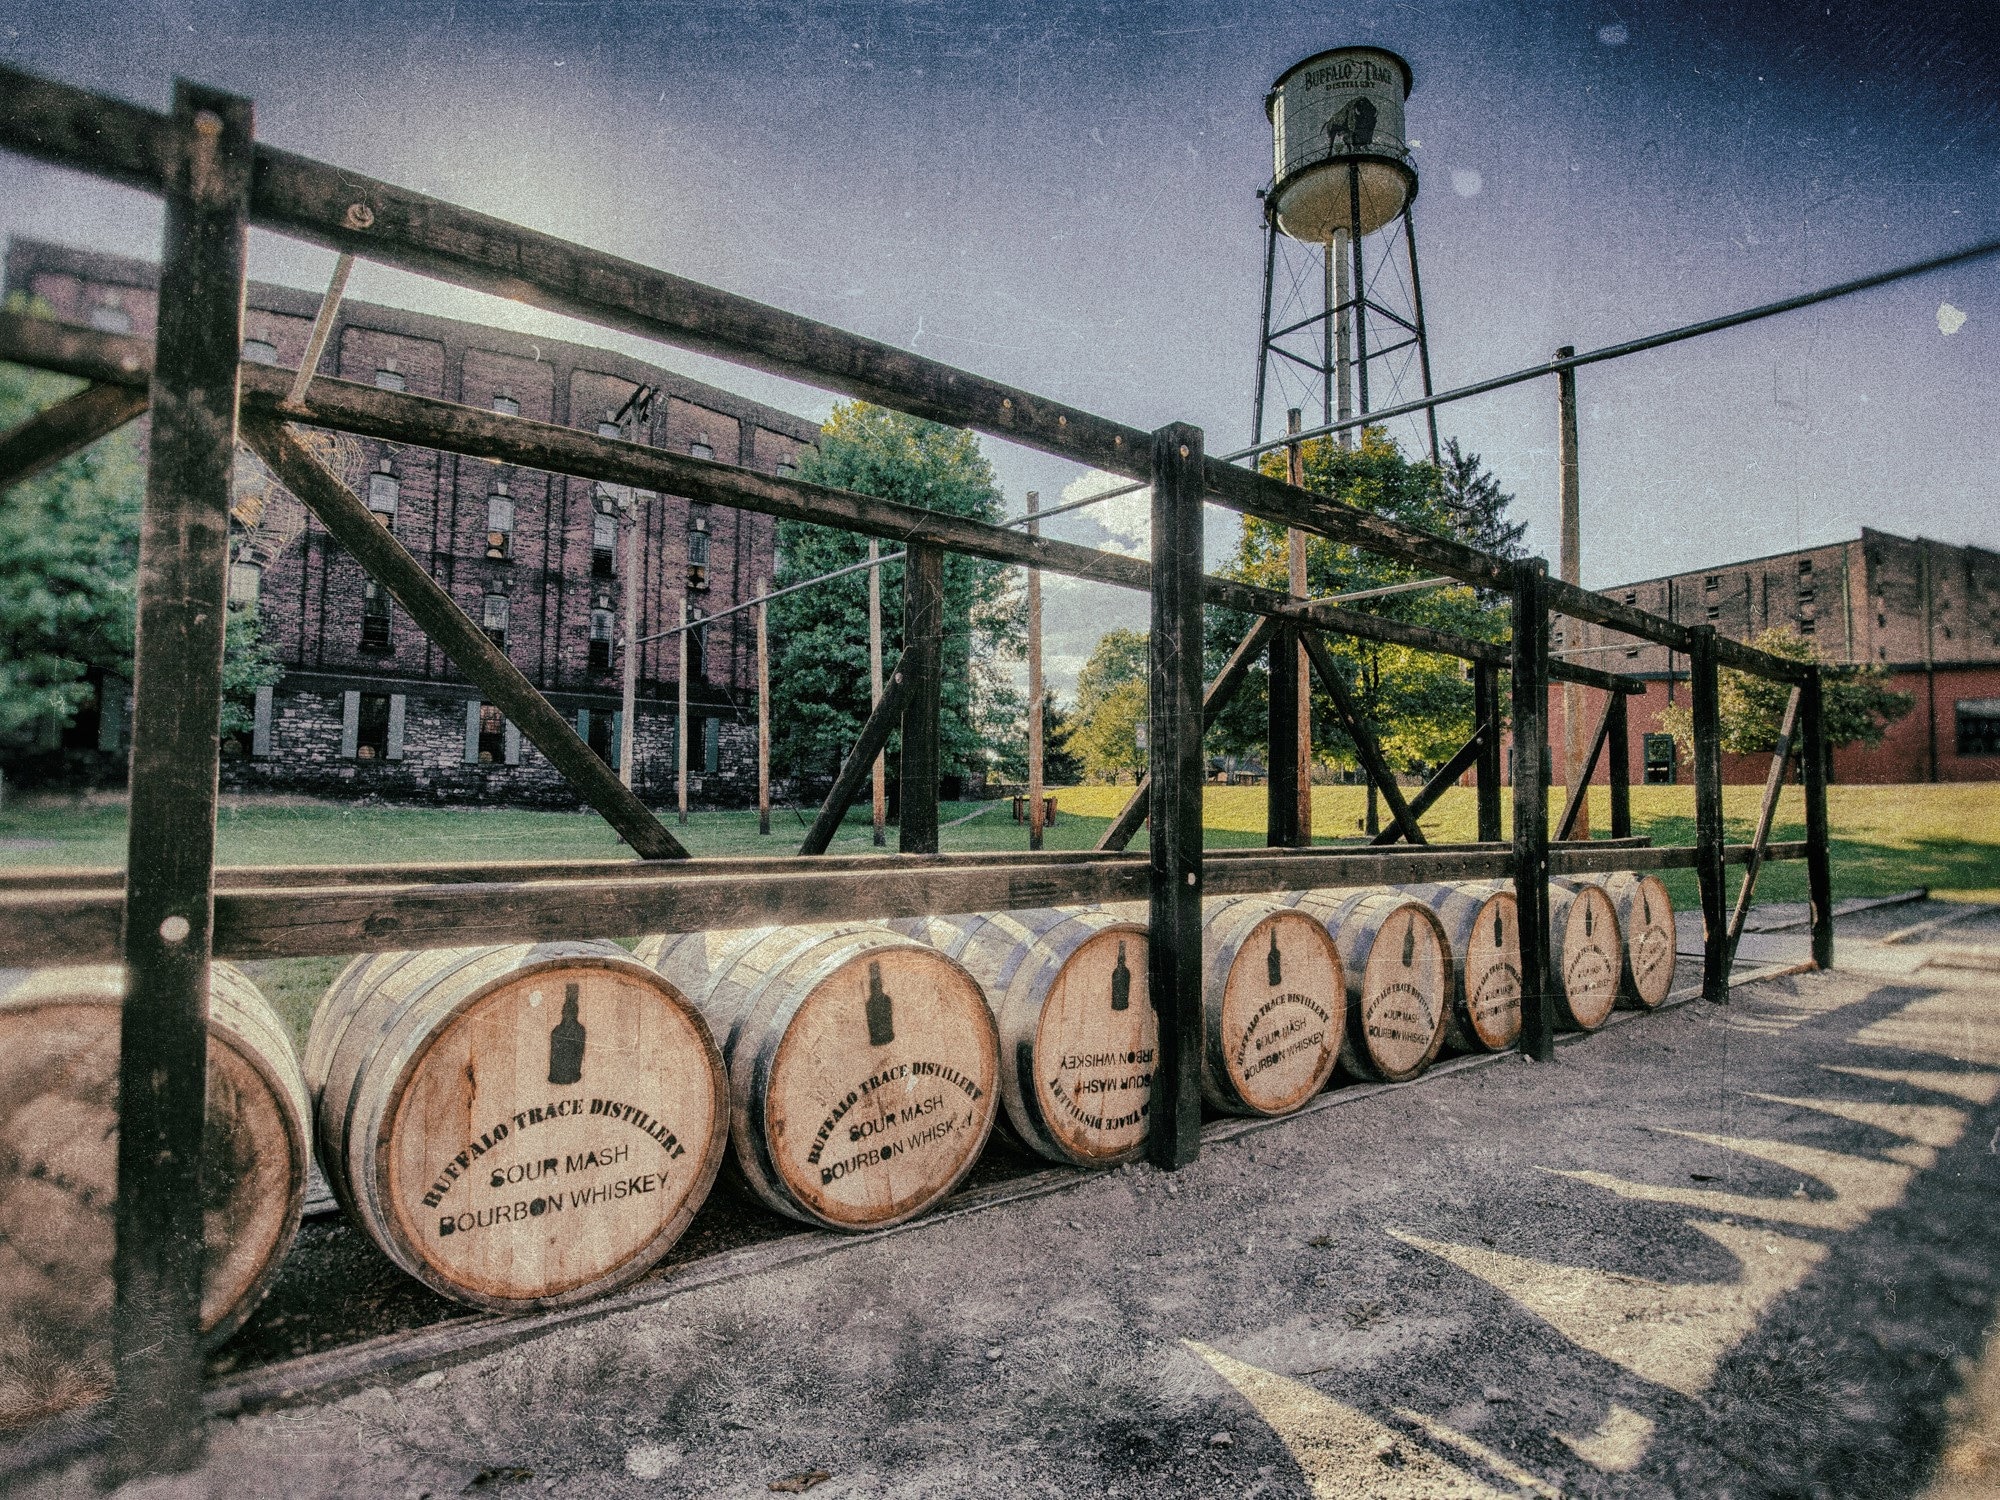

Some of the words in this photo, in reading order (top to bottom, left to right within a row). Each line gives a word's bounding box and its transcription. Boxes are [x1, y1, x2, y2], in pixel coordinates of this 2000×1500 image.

[1305, 63, 1352, 91] BUFFALO
[1287, 993, 1329, 1023] DISTILLERY
[1060, 1052, 1116, 1069] WHISKEY
[1244, 1050, 1285, 1081] BOURBON
[1287, 1030, 1324, 1056] WHISKEY
[1083, 1078, 1117, 1094] MASH
[807, 1092, 858, 1164] BUFFALO
[859, 1064, 908, 1095] TRACE
[912, 1062, 983, 1101] DISTILLERY
[850, 1113, 897, 1142] SOUR
[901, 1094, 944, 1123] MASH
[421, 1123, 508, 1209] BUFFALO
[513, 1098, 583, 1130] TRACE
[589, 1098, 686, 1160] DISTILLERY
[490, 1158, 558, 1187] SOUR
[566, 1144, 628, 1173] MASH
[821, 1140, 904, 1185] BOURBON
[907, 1110, 972, 1150] WHISKY
[439, 1193, 562, 1237] BOURBON
[570, 1171, 669, 1208] WHISKEY
